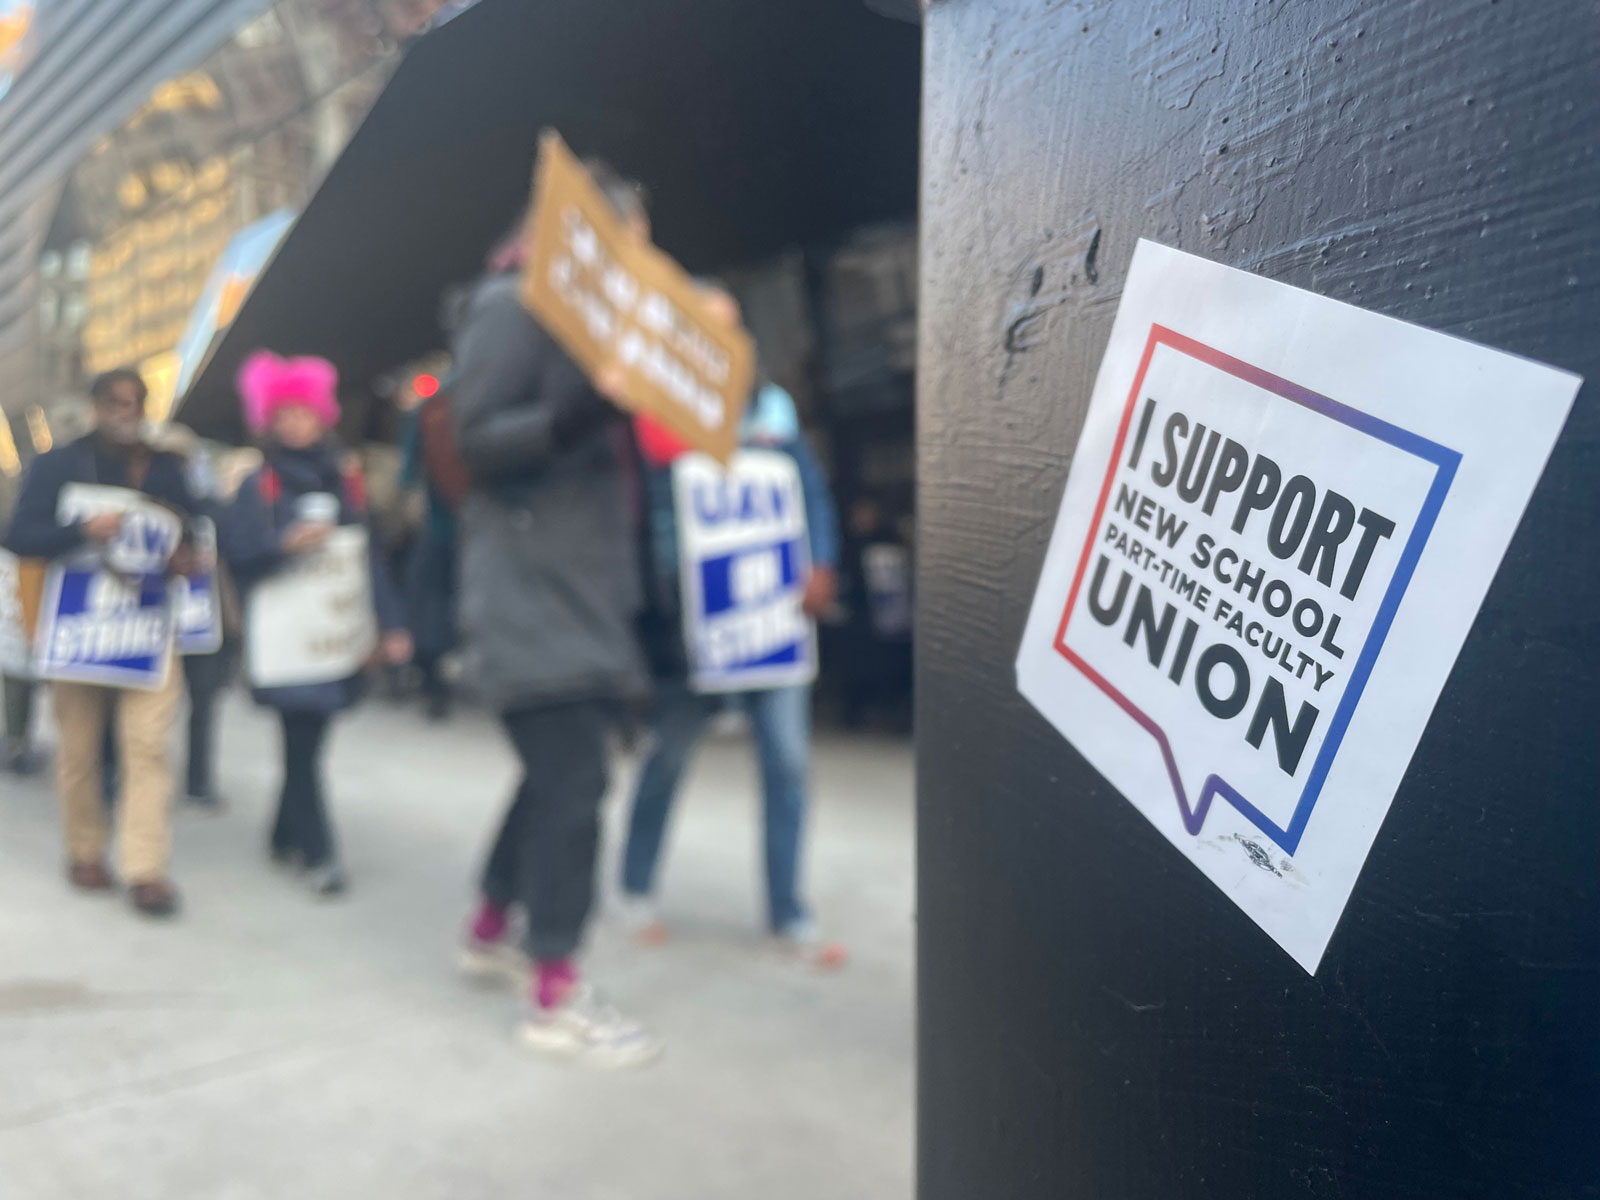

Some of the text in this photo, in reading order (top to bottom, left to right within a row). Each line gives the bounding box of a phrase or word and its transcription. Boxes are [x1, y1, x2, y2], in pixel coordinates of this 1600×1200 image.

[1115, 483, 1345, 660] NEW SCHOOL
[1128, 398, 1397, 602] I SUPPORT
[1087, 555, 1320, 778] UNION
[1105, 523, 1335, 692] PART-TIME FACULTY
